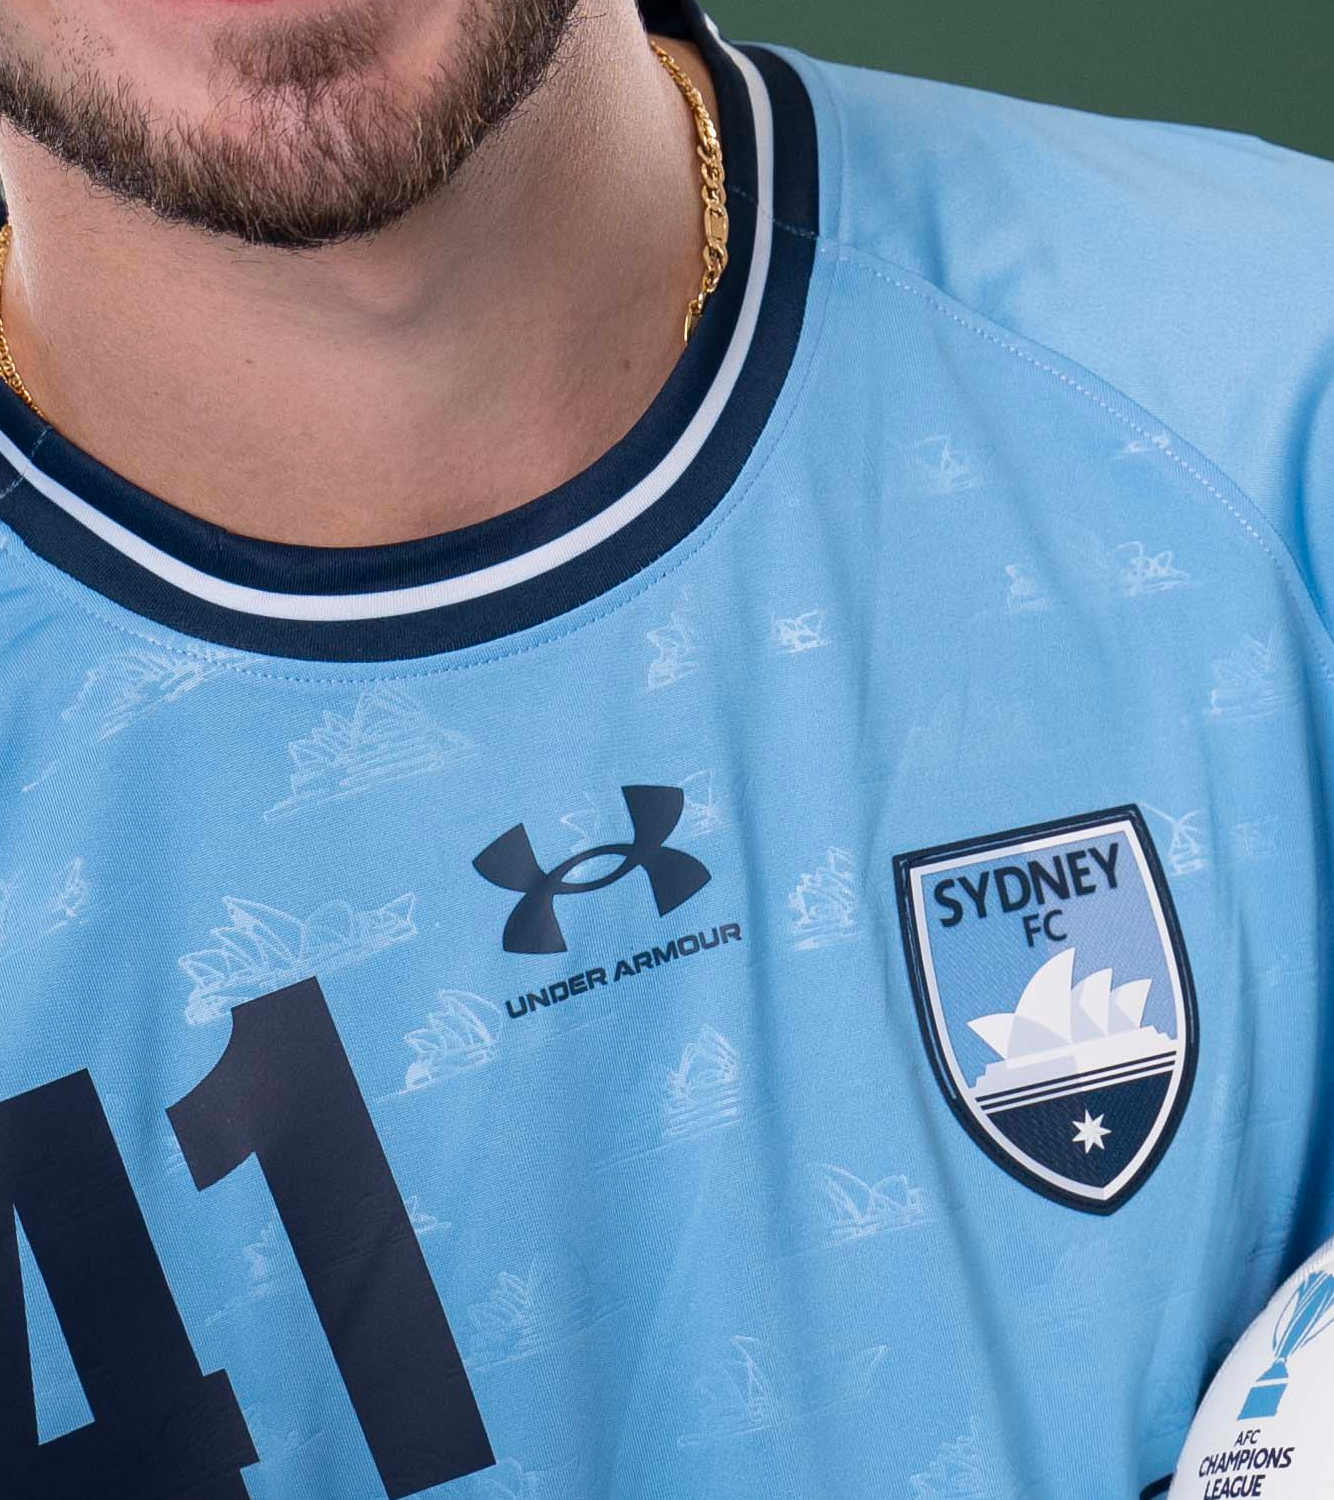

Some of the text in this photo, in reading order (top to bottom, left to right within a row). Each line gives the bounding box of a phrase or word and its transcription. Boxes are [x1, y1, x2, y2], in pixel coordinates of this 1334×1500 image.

[934, 842, 1119, 928] SYDNEY
[1024, 909, 1067, 948] FC
[505, 922, 743, 1019] UNDER ARMOUR
[1234, 1429, 1261, 1447] AFC
[1198, 1447, 1296, 1478] CHAMPIONS
[1203, 1474, 1266, 1500] LEAGUE
